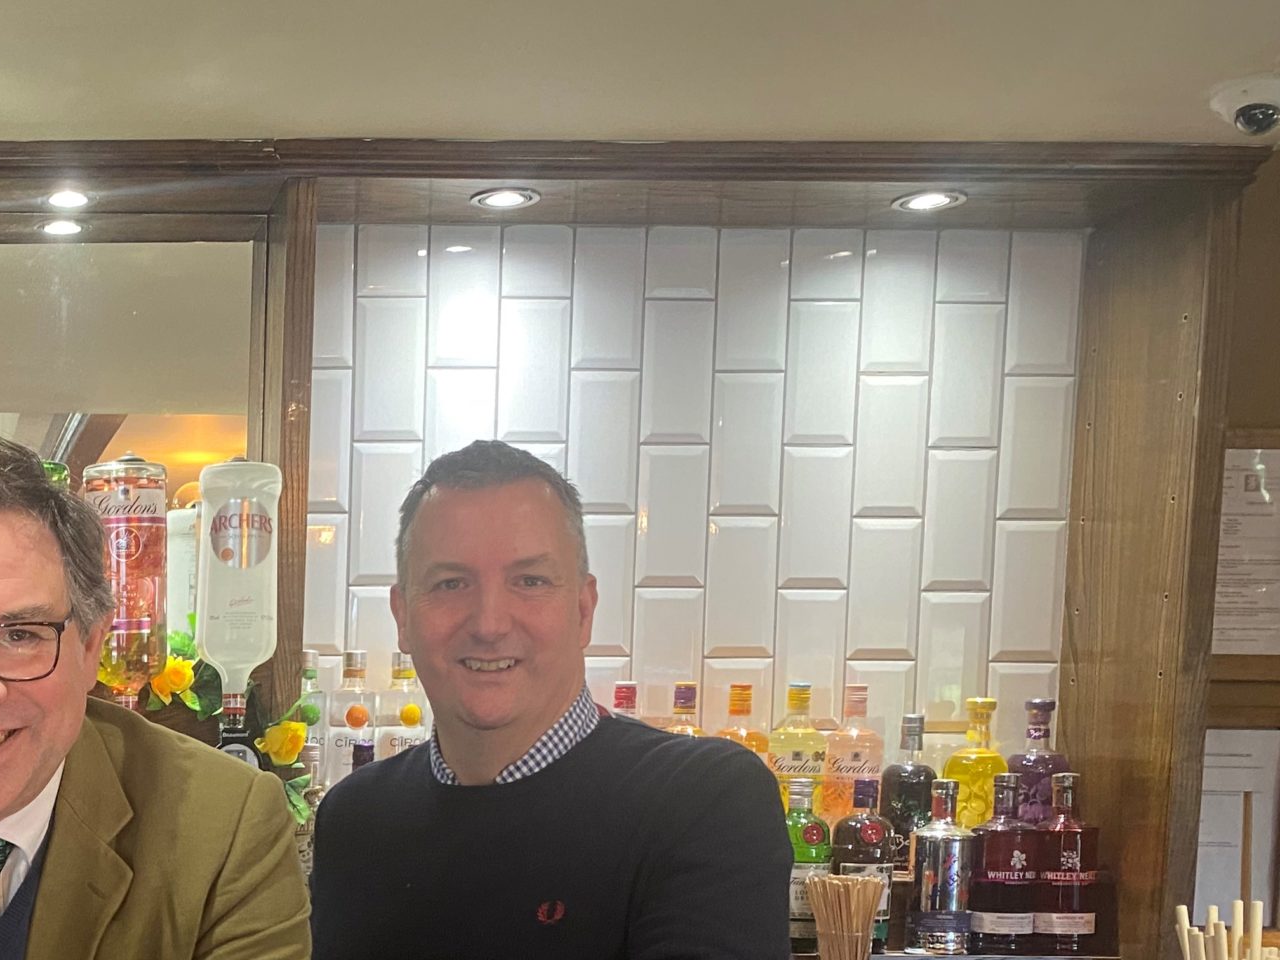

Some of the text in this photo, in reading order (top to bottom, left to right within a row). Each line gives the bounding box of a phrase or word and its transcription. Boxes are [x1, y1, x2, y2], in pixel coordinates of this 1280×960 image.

[94, 495, 160, 516] Gordon's
[211, 513, 273, 534] ARCHERS
[987, 871, 1023, 880] WHITLEY
